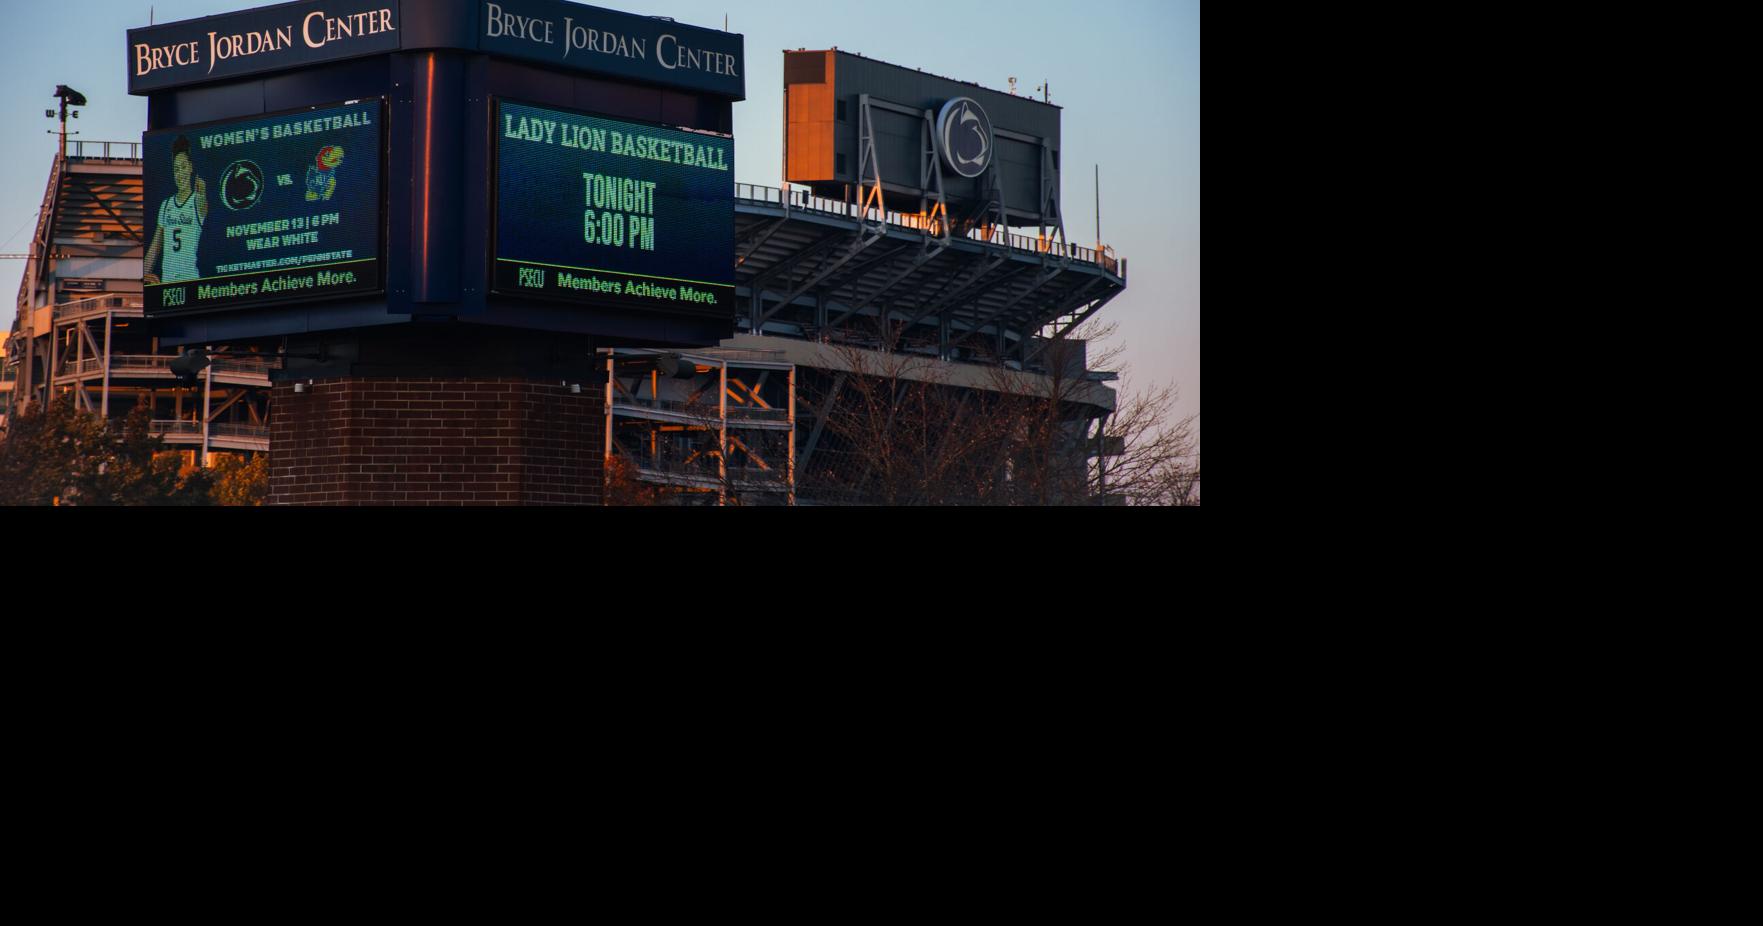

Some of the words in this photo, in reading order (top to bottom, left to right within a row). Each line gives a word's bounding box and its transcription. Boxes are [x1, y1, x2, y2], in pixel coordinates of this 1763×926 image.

[135, 42, 199, 76] BRYCE
[207, 26, 293, 74] JORDAN
[302, 8, 395, 49] CENTER
[486, 2, 553, 44] BRYCE
[563, 17, 646, 58] JORDAN
[656, 34, 738, 77] CENTER
[272, 112, 371, 138] BASKETBALL
[505, 114, 556, 144] LADY
[561, 123, 606, 151] LION
[610, 131, 728, 171] BASKETBALL
[583, 173, 656, 215] TONIGHT
[172, 229, 182, 252] 5
[226, 219, 289, 238] NOVEMBER
[290, 216, 304, 230] 13
[312, 216, 320, 227] 6
[321, 213, 339, 225] PM
[246, 236, 279, 251] WEAR
[282, 231, 319, 246] WHITE
[584, 209, 624, 247] 6:00
[629, 215, 654, 251] PM
[198, 281, 258, 300] Members
[261, 275, 314, 295] Achieve
[317, 270, 357, 286] More.
[558, 272, 622, 295] Members
[624, 280, 677, 300] Achieve
[680, 286, 718, 305] More.
